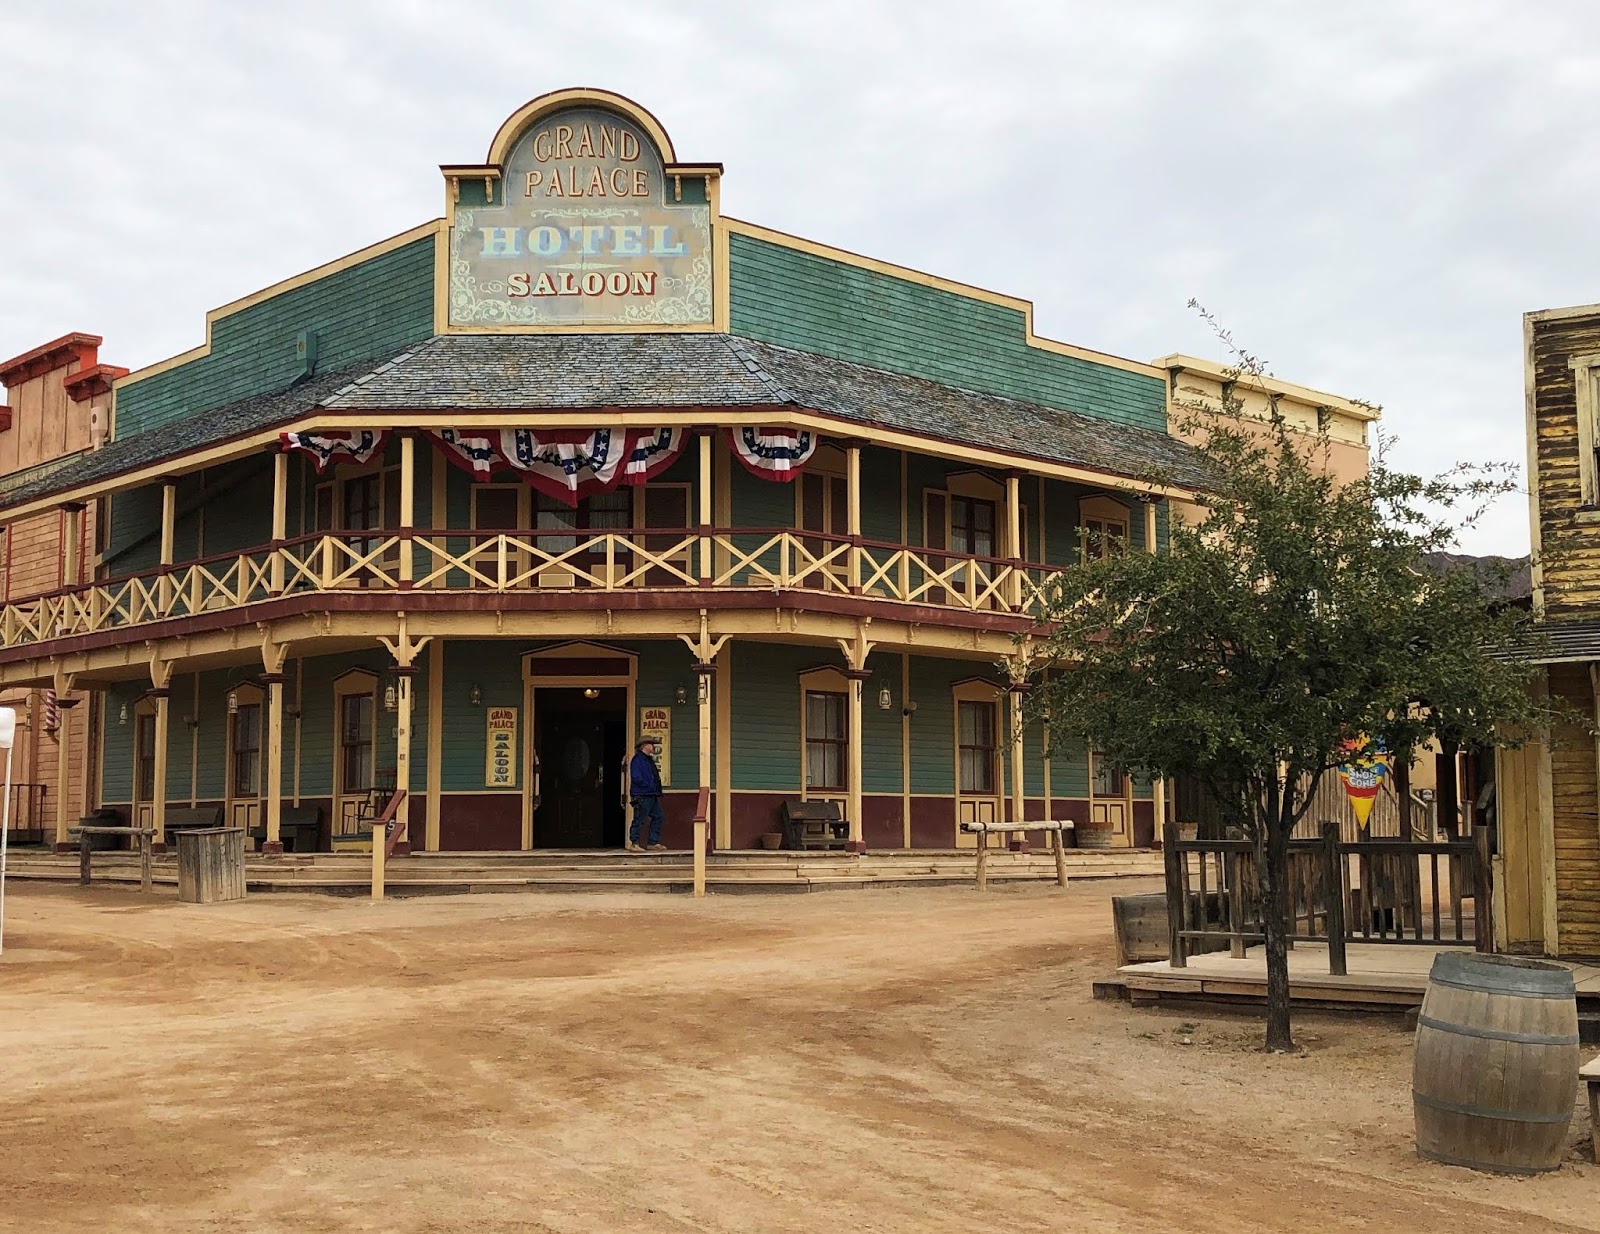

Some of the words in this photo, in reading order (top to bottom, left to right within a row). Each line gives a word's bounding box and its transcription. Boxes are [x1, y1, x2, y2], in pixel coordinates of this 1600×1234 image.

[533, 124, 640, 162] GRAND
[524, 166, 649, 197] PALACE
[479, 225, 689, 258] HOTEL
[507, 272, 657, 296] SALOON
[491, 710, 513, 720] GRAND
[643, 721, 668, 729] PALACE
[645, 710, 666, 719] GRAND
[494, 734, 510, 782] SALOON
[1349, 777, 1376, 786] CONE
